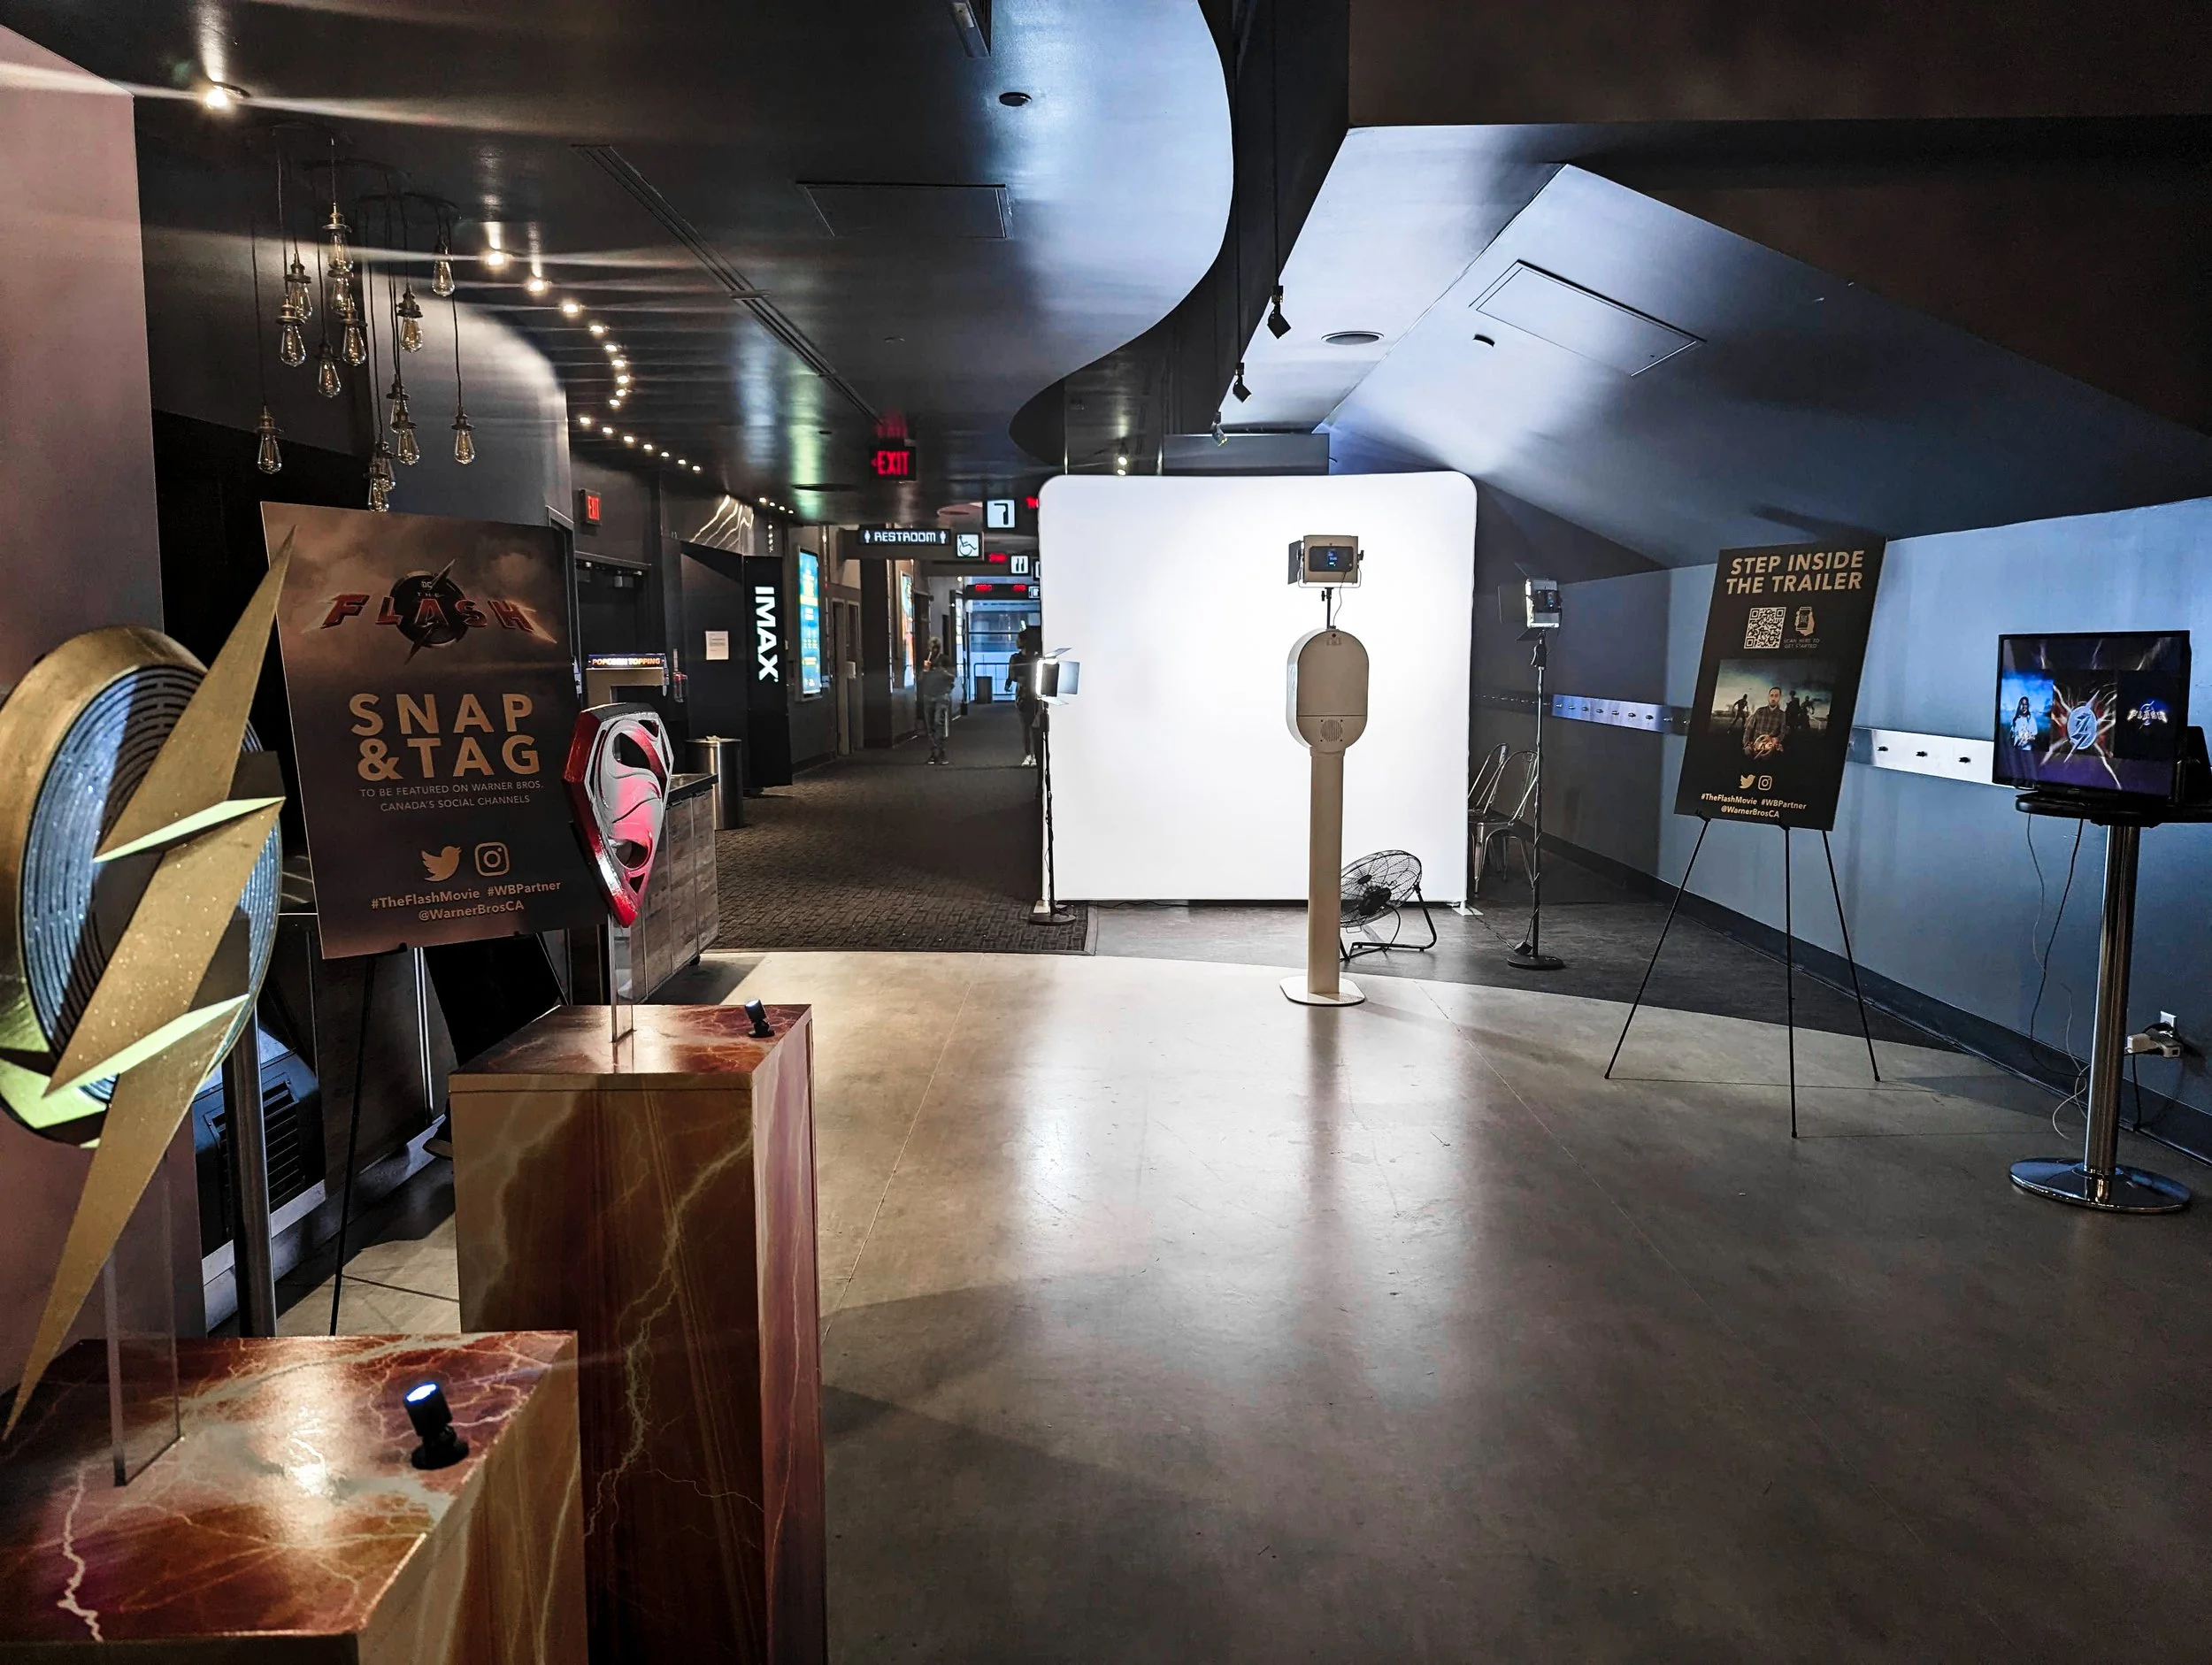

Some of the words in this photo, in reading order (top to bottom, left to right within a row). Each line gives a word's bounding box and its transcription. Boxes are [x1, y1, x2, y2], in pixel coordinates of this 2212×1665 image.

[877, 451, 910, 475] EXIT
[587, 495, 600, 520] EXIT
[993, 503, 1009, 526] 7
[874, 532, 937, 542] RESTROOM
[1731, 556, 1781, 575] STEP
[1787, 550, 1865, 572] INSIDE
[1726, 577, 1764, 595] THE
[1771, 572, 1863, 593] TRAILER
[319, 594, 537, 634] FLASH
[755, 587, 779, 682] IMAX
[349, 693, 533, 736] SNAP
[359, 788, 375, 797] TO
[380, 786, 393, 796] BE
[396, 785, 449, 795] FEATURED
[472, 782, 513, 792] WARNER
[516, 780, 544, 789] BROS.
[380, 801, 434, 811] CANADA'S
[438, 799, 475, 808] SOCIAL
[479, 795, 531, 806] CHANNELS
[1701, 793, 1758, 805] #TheFlashMovie
[1761, 798, 1807, 809] #WBPartner
[1721, 805, 1780, 818] @WarnerBrosCA
[371, 888, 480, 909] #TheFlashMovie
[488, 881, 562, 897] #WBPartner
[418, 900, 525, 922] @WarnerBrosCA
